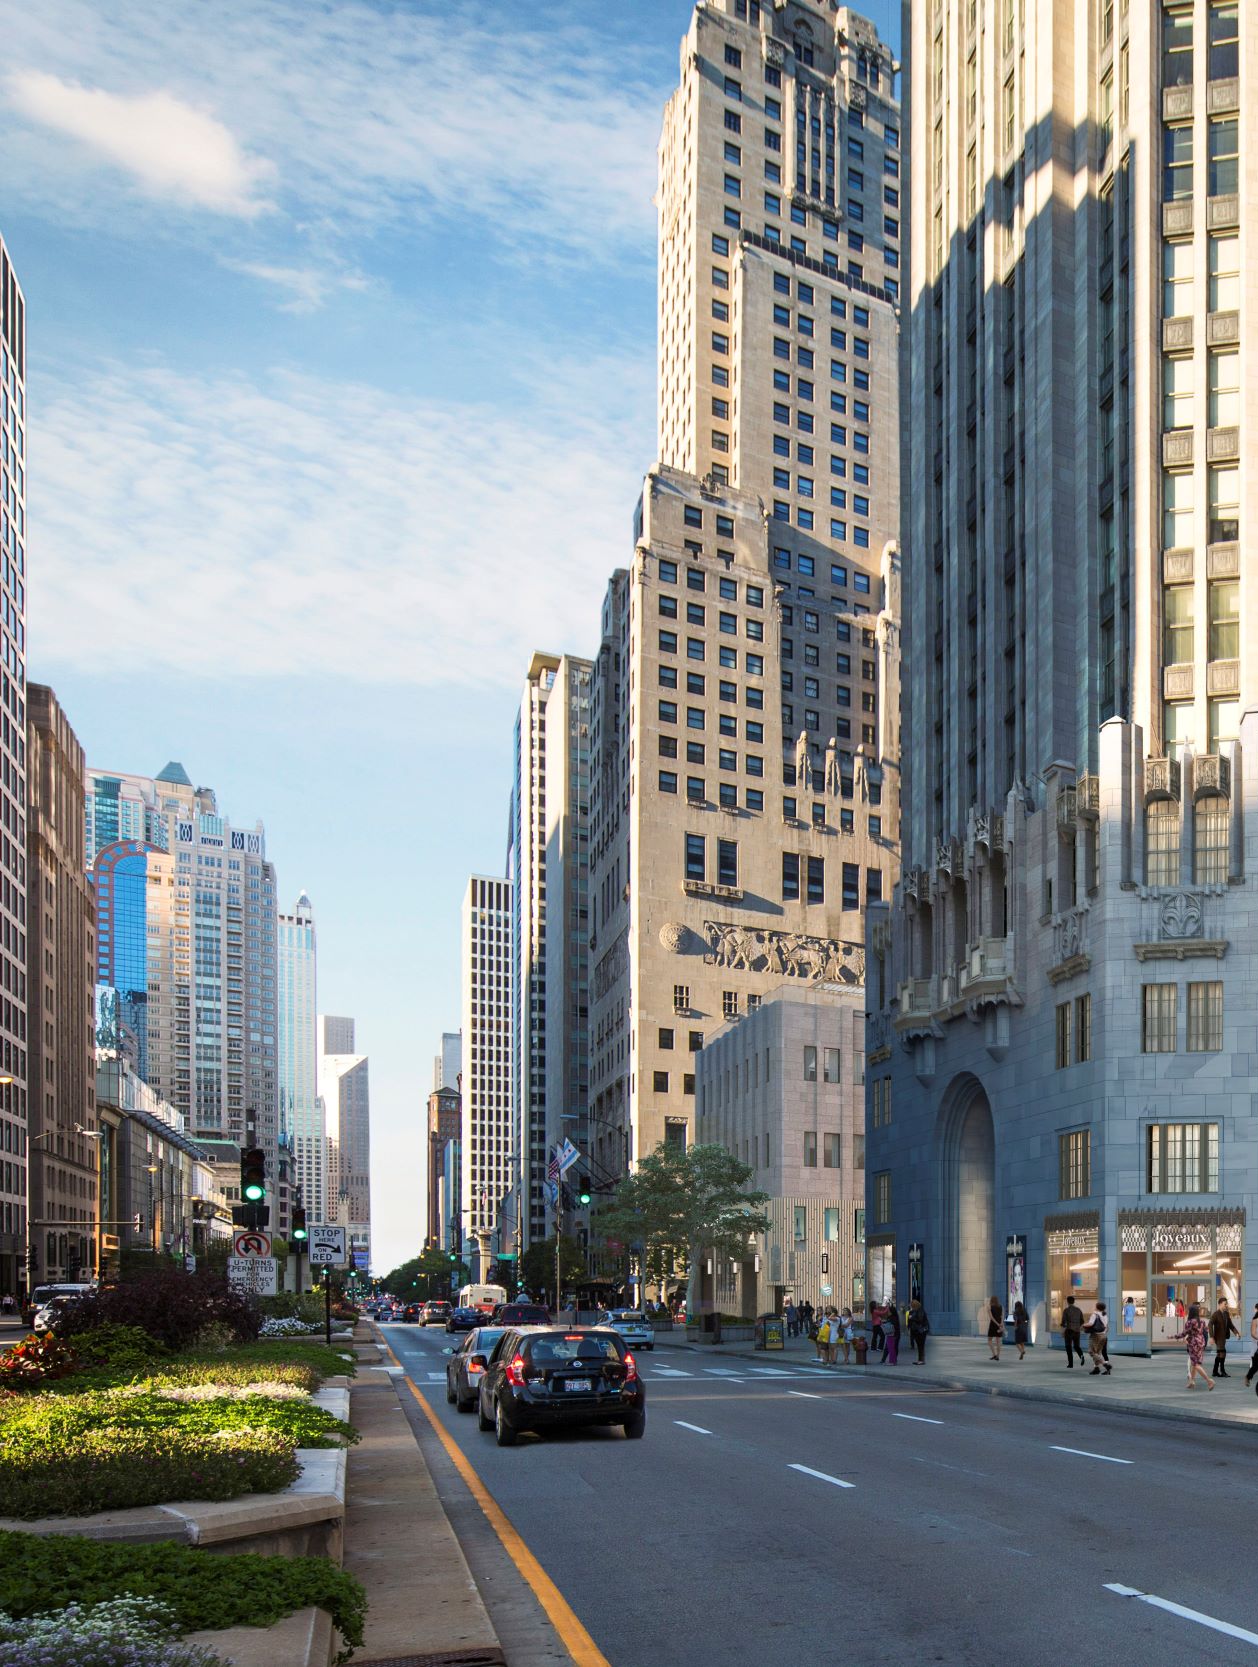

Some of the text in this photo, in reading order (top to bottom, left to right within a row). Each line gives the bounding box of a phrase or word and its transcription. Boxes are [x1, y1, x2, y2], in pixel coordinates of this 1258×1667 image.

[313, 1229, 340, 1237] STOP
[1153, 1231, 1208, 1246] Joyeaux
[312, 1253, 332, 1261] RED
